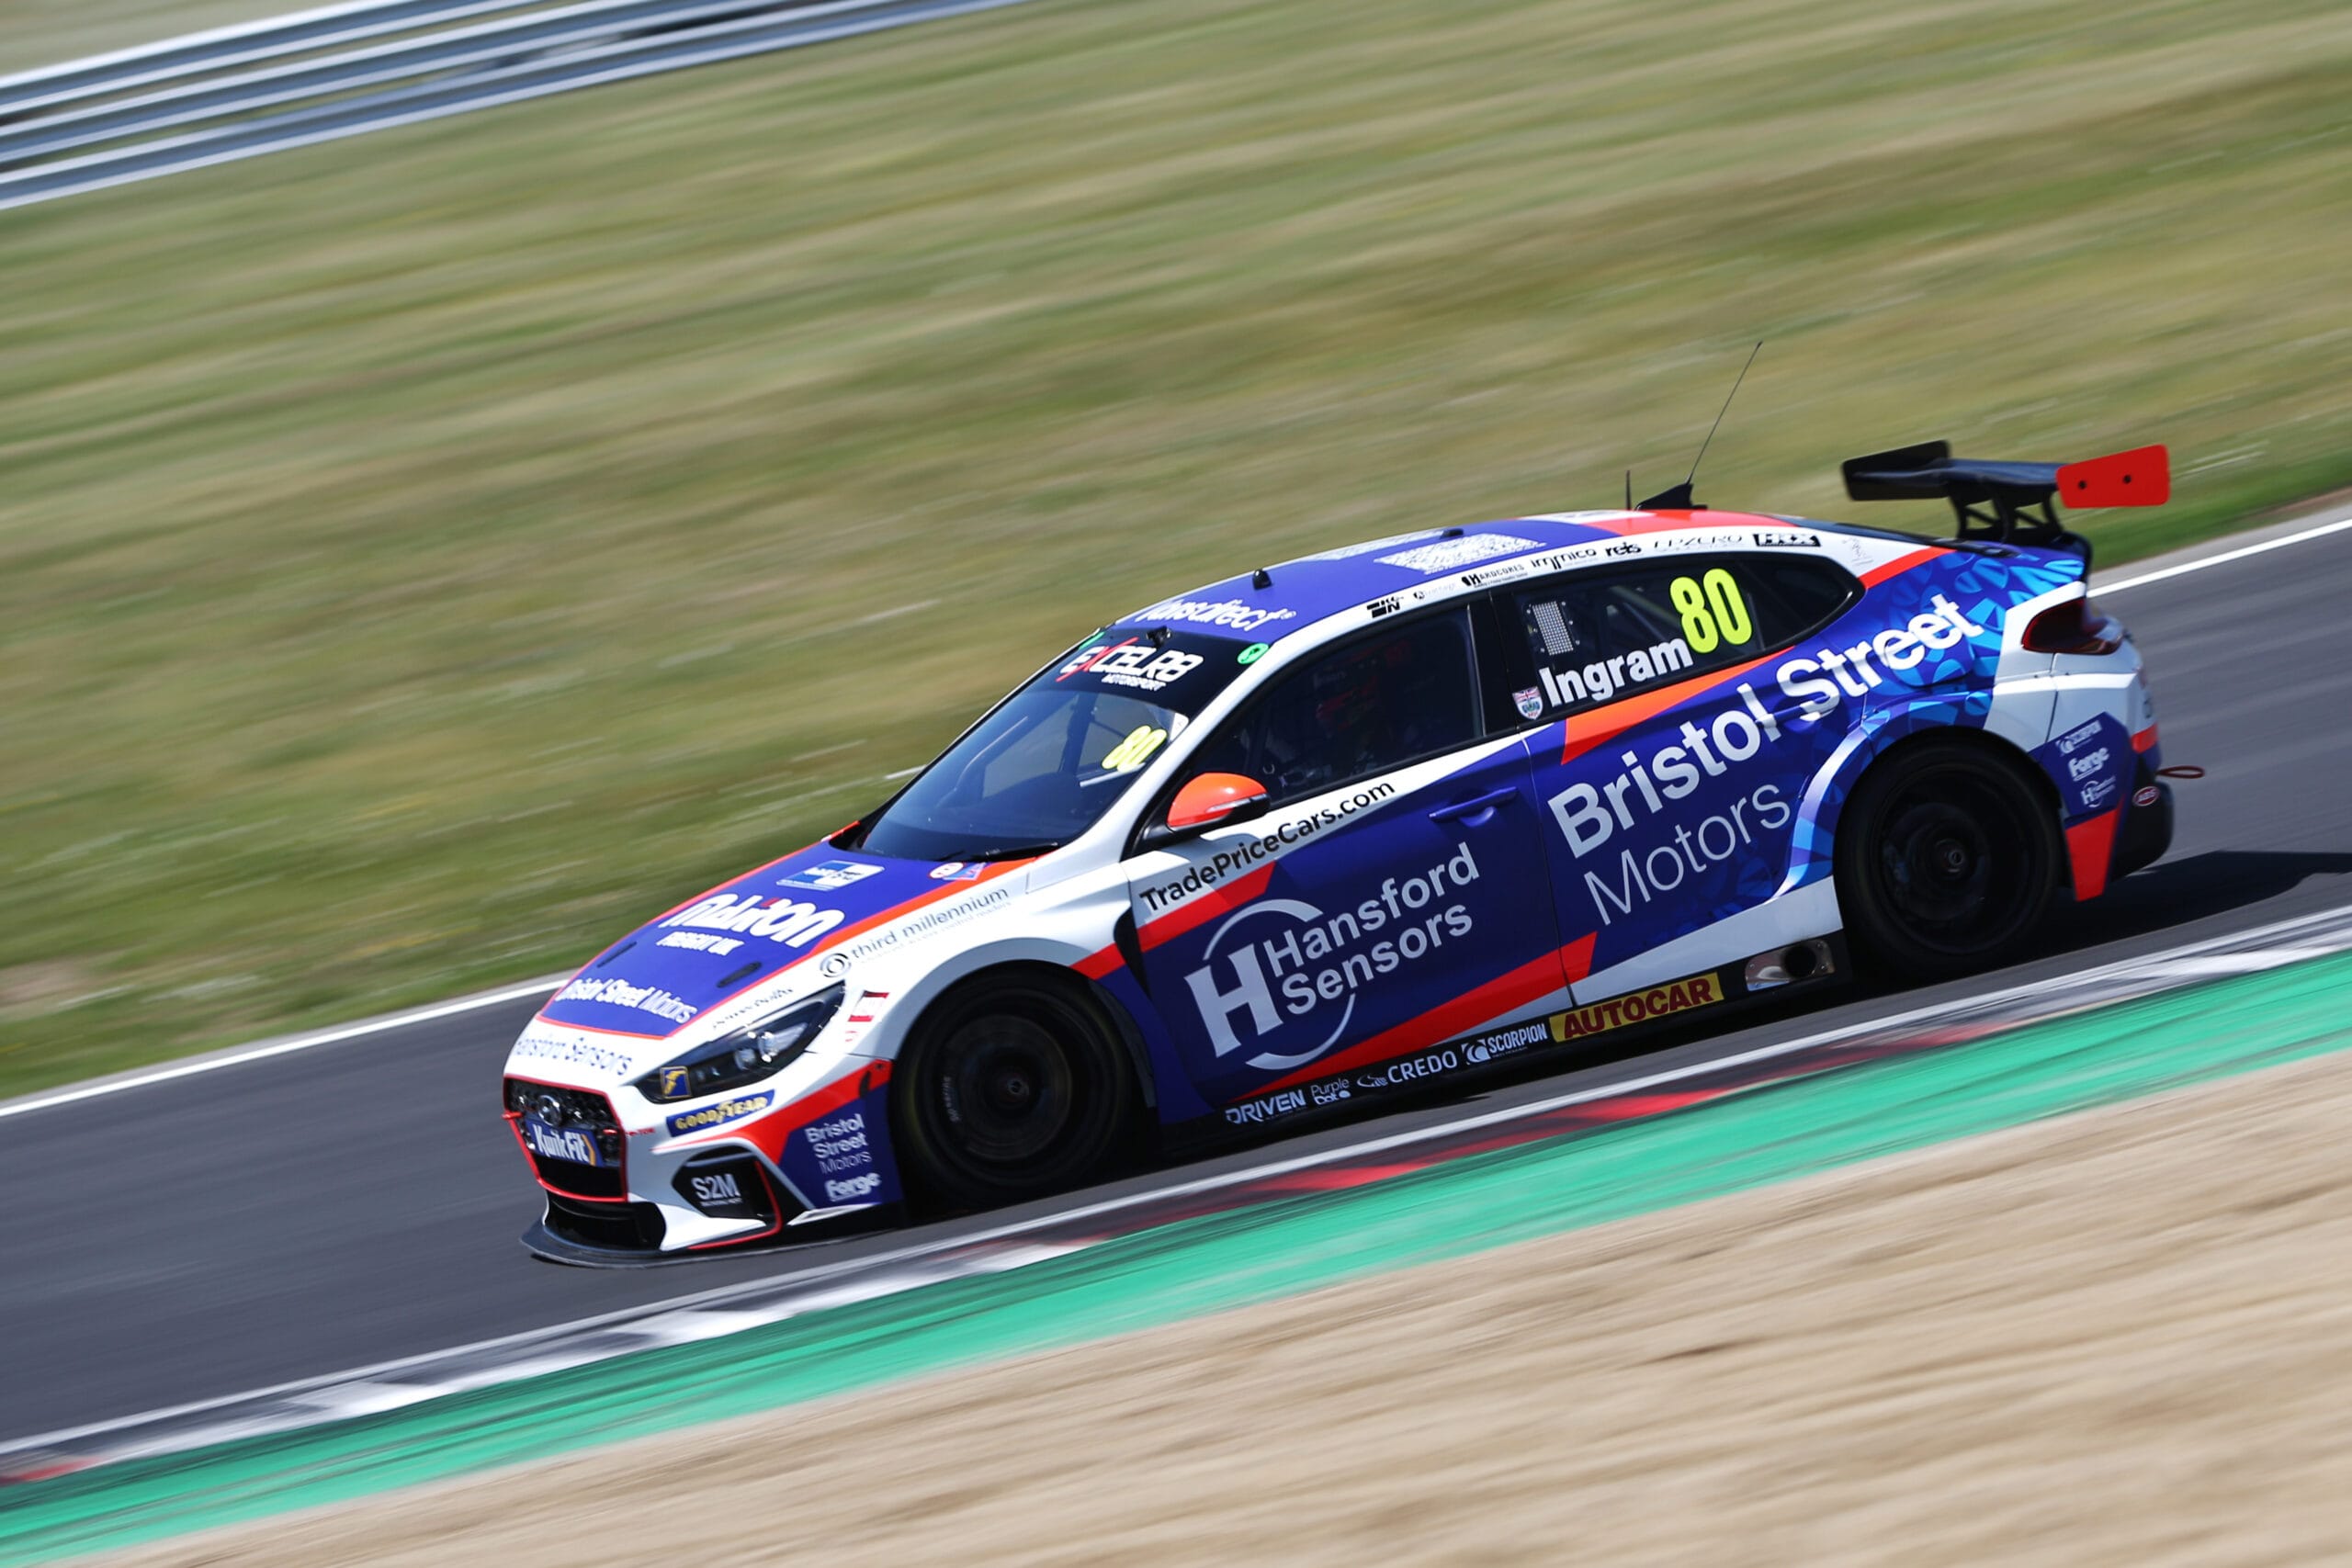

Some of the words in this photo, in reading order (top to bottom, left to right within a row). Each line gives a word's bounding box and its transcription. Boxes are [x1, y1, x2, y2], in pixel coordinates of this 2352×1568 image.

[1669, 568, 1753, 654] 80
[1538, 637, 1695, 709] Ingram
[1102, 725, 1167, 773] 80
[1548, 682, 1781, 860] Bristol
[1776, 593, 1984, 722] Street
[1139, 779, 1395, 914] TradePriceCars.com
[1584, 783, 1791, 927] Motors
[901, 888, 1009, 937] millennium
[1262, 841, 1480, 976] Hansford
[1281, 903, 1473, 1016] Sensors
[1564, 982, 1714, 1039] AUTOCAR
[1487, 1022, 1548, 1055] SCORPION
[1310, 1077, 1349, 1097] Purple
[1387, 1051, 1458, 1084] CREDO
[675, 1097, 768, 1130] GOODYEAR
[805, 1113, 865, 1143] Bristol
[1225, 1089, 1306, 1124] DRIVEN
[813, 1132, 868, 1158] Street
[819, 1151, 872, 1174] Motors
[692, 1173, 741, 1200] S2M
